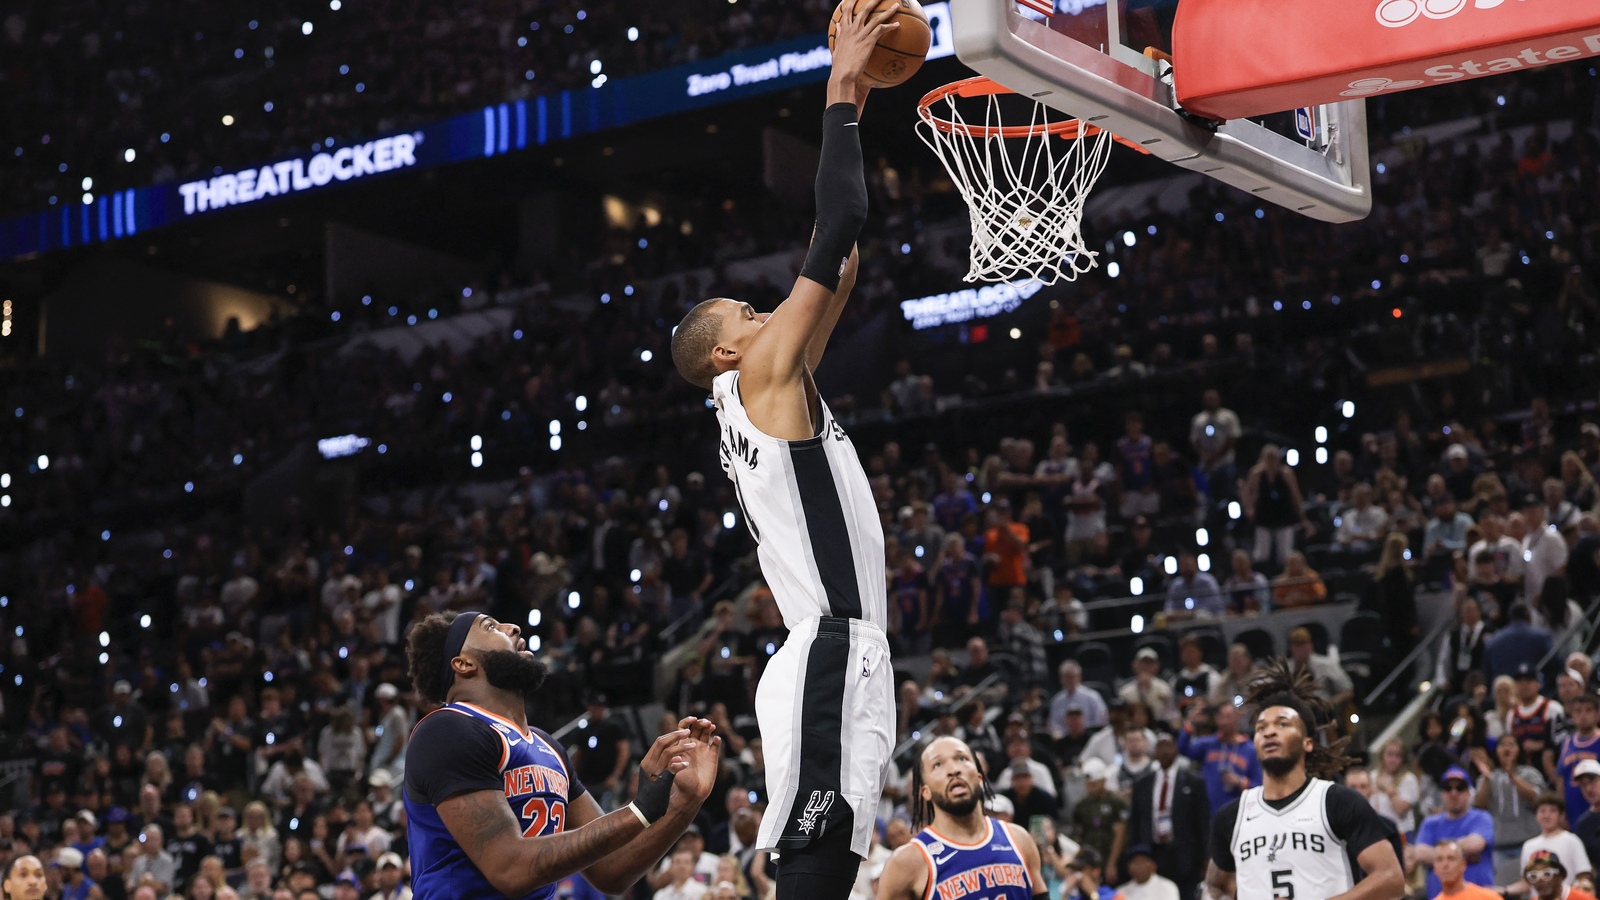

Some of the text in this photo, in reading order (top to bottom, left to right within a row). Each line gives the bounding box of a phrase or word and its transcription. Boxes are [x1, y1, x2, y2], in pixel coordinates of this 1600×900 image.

[687, 72, 732, 97] Zero
[730, 62, 780, 87] Trust
[1425, 45, 1581, 82] State
[178, 133, 417, 215] THREATLOCKER
[503, 765, 546, 798] NEW
[521, 797, 566, 838] 23
[937, 862, 1027, 900] NEW YORK
[1271, 869, 1295, 900] 5
